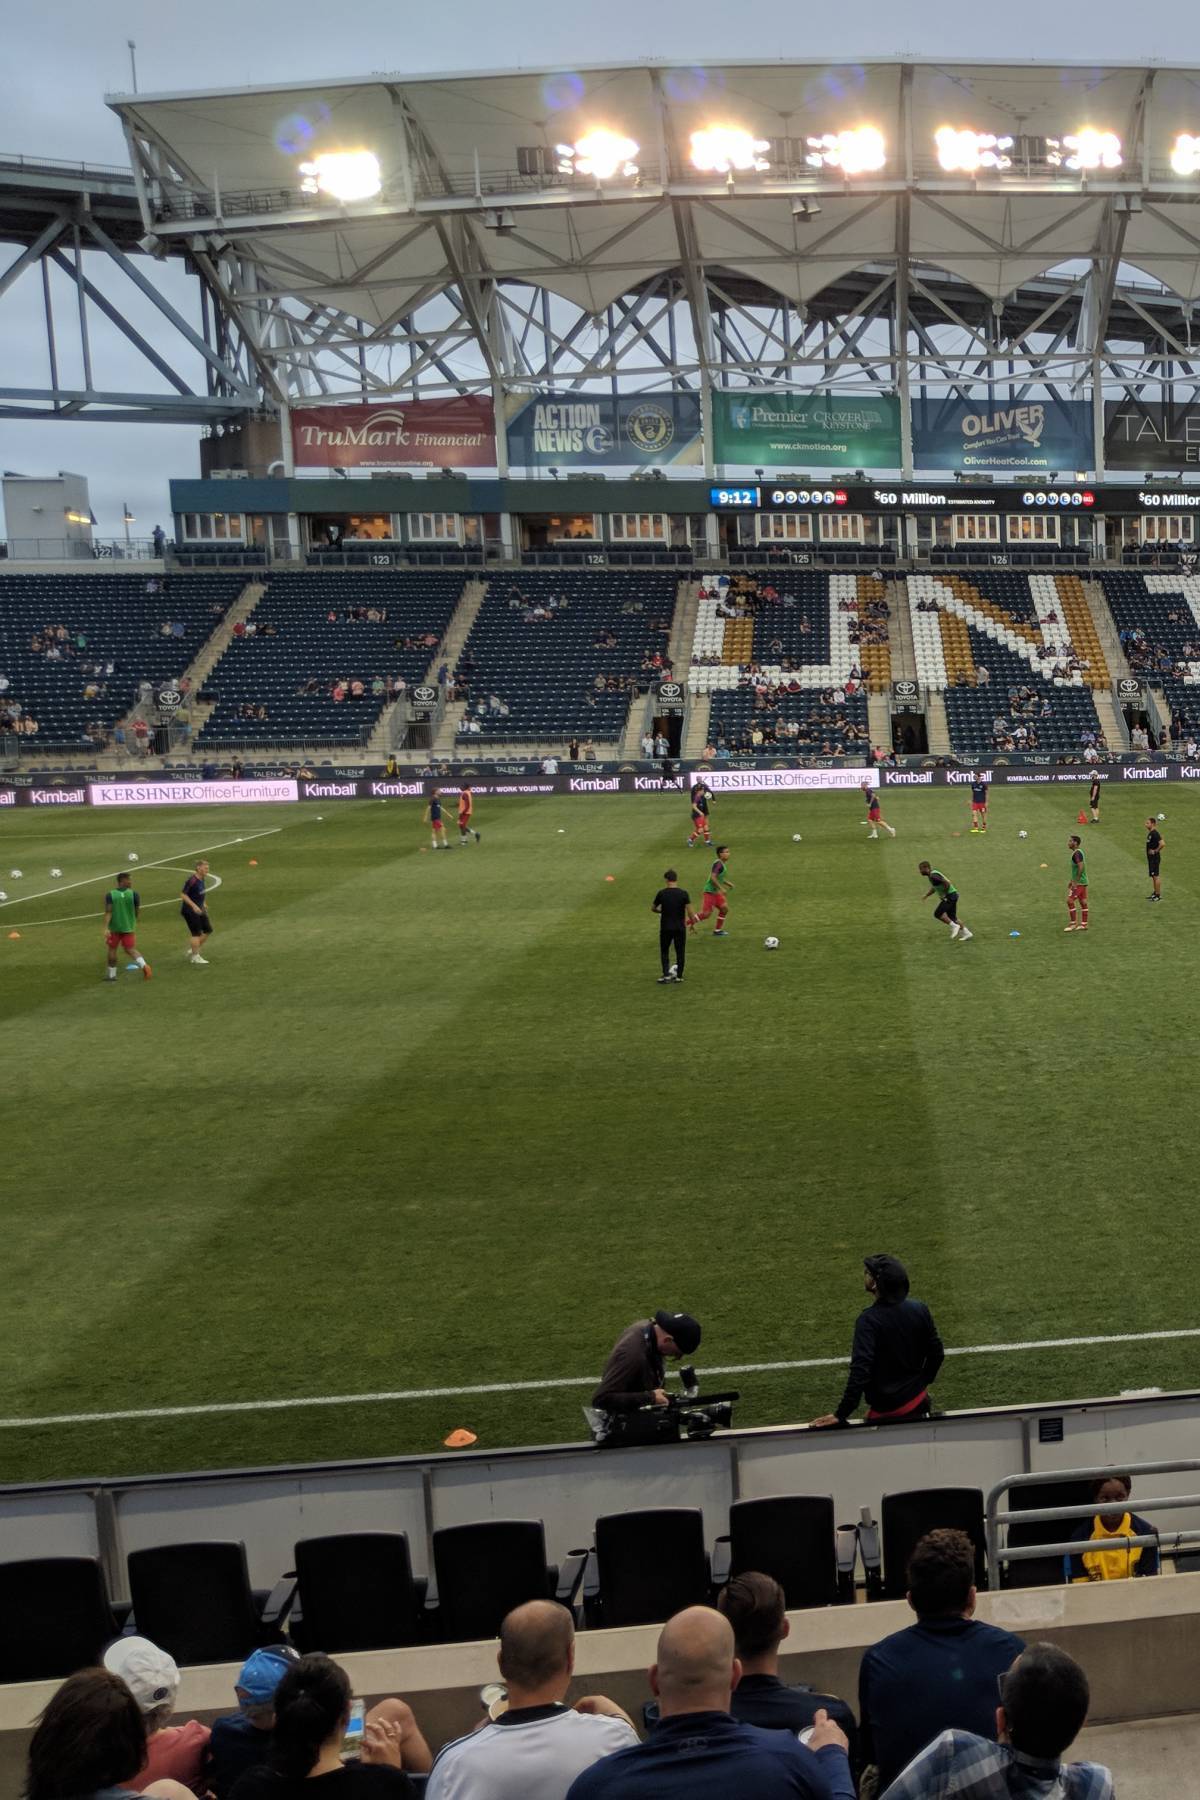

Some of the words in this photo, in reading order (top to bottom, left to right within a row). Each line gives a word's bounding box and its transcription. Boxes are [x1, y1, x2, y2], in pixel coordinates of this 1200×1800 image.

[534, 404, 600, 428] ACTION
[752, 407, 808, 422] Premier
[813, 410, 862, 422] CROZER
[962, 404, 1044, 437] OLIVER
[822, 421, 871, 431] KEYSTONE
[301, 425, 410, 446] TruMark
[415, 433, 482, 446] Financial
[534, 430, 584, 452] NEWS
[770, 442, 847, 452] www.ckmotion.org
[963, 456, 1047, 466] OliverHeatCool.com
[718, 491, 751, 504] 9:12
[874, 491, 897, 505] $60
[902, 492, 946, 505] Million
[1139, 492, 1161, 506] $60
[93, 547, 112, 559] 122
[793, 554, 810, 564] 125
[373, 554, 390, 565] 123
[588, 554, 604, 565] 124
[992, 555, 1008, 565] 126
[659, 696, 683, 704] TOYOTA
[894, 693, 918, 701] TOYOTA
[1119, 691, 1141, 699] TOYOTA
[253, 770, 277, 778] TALEN
[885, 770, 933, 784] Kimball
[1123, 767, 1169, 779] Kimball
[305, 782, 357, 796] Kimball
[372, 781, 424, 796] Kimball
[570, 777, 620, 791] Kimball
[31, 789, 86, 804] Kimball
